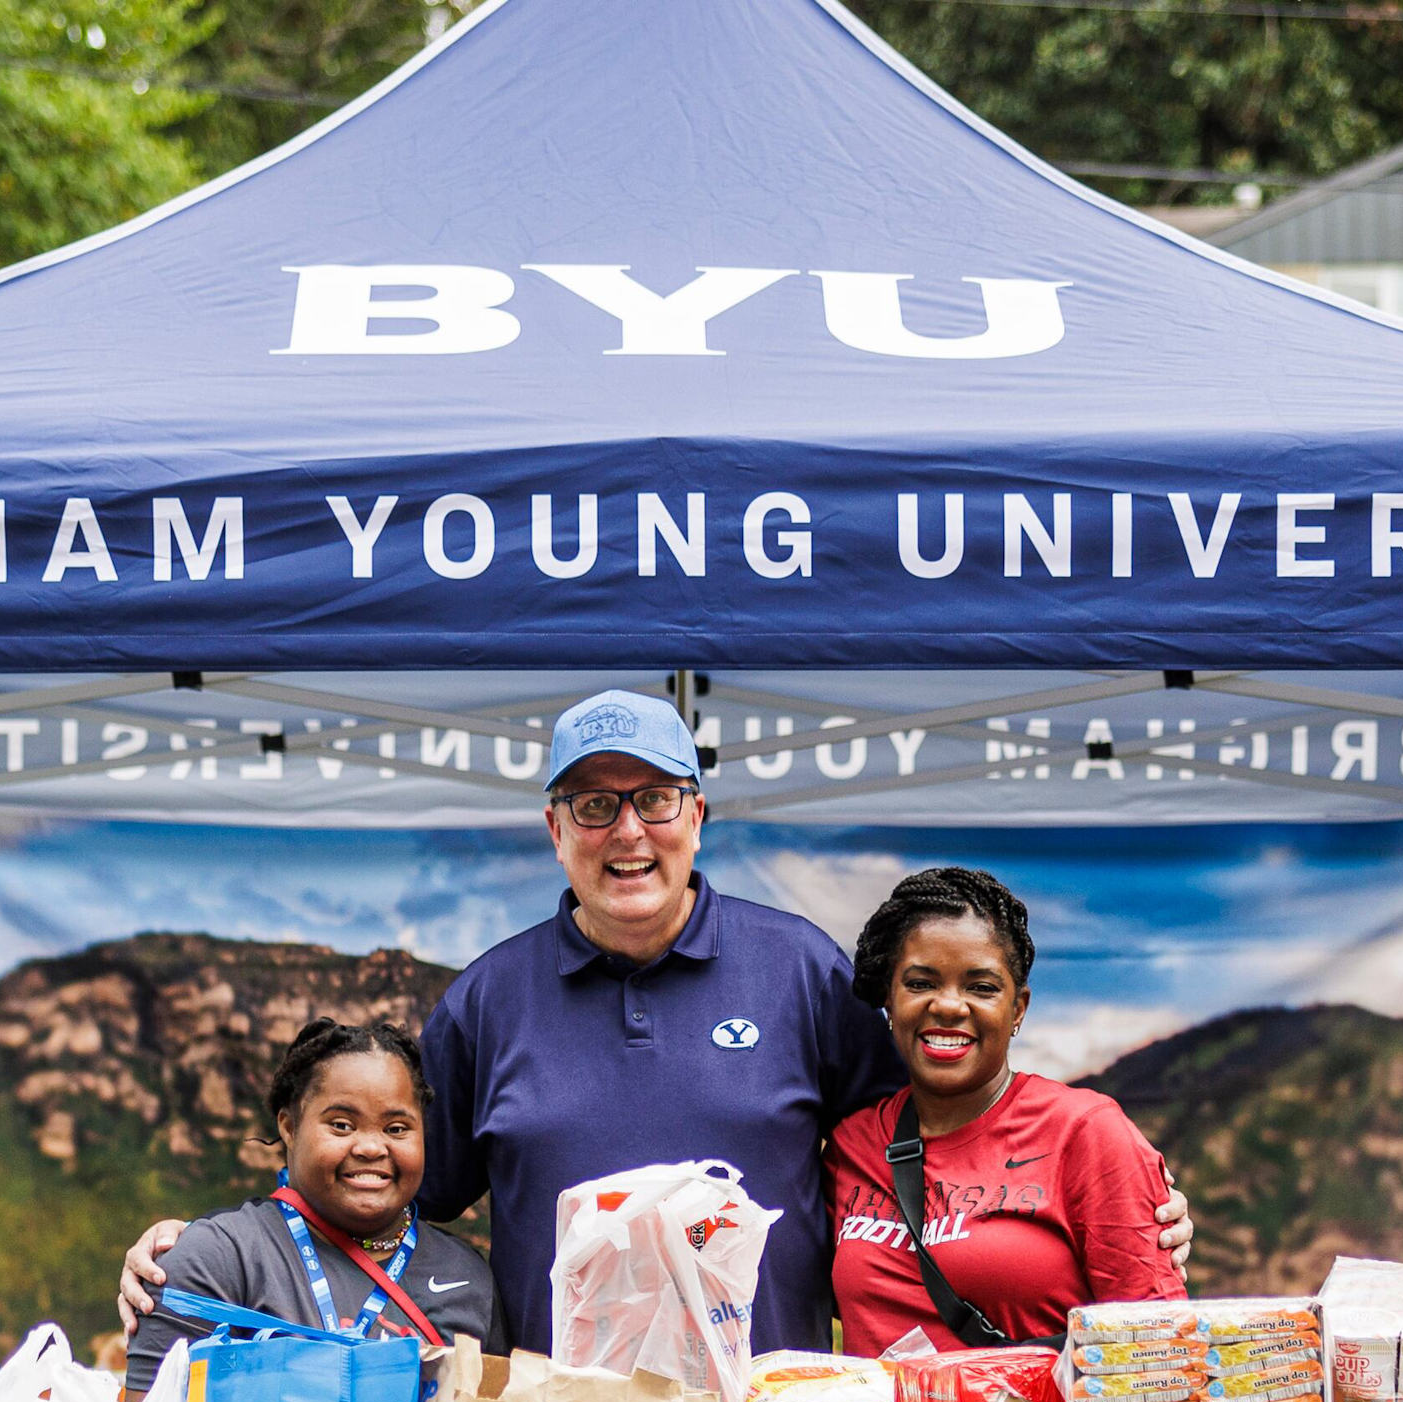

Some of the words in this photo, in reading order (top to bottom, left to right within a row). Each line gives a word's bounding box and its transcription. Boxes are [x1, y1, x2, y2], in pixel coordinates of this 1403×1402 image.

[268, 264, 1074, 360] BYU
[326, 492, 812, 580] YOUNG
[580, 715, 637, 748] BYU
[719, 1022, 753, 1045] Y
[1240, 1321, 1275, 1330] Ramen
[1277, 1319, 1296, 1329] Top
[1286, 1338, 1304, 1348] Top
[1132, 1348, 1167, 1358] Ramen
[1169, 1346, 1188, 1356] Top
[1249, 1343, 1284, 1356] Ramen
[1335, 1355, 1370, 1372] CUP
[1291, 1371, 1310, 1381] Top
[1132, 1379, 1167, 1389] Ramen
[1169, 1377, 1188, 1386] Top
[1253, 1375, 1289, 1388] Ramen
